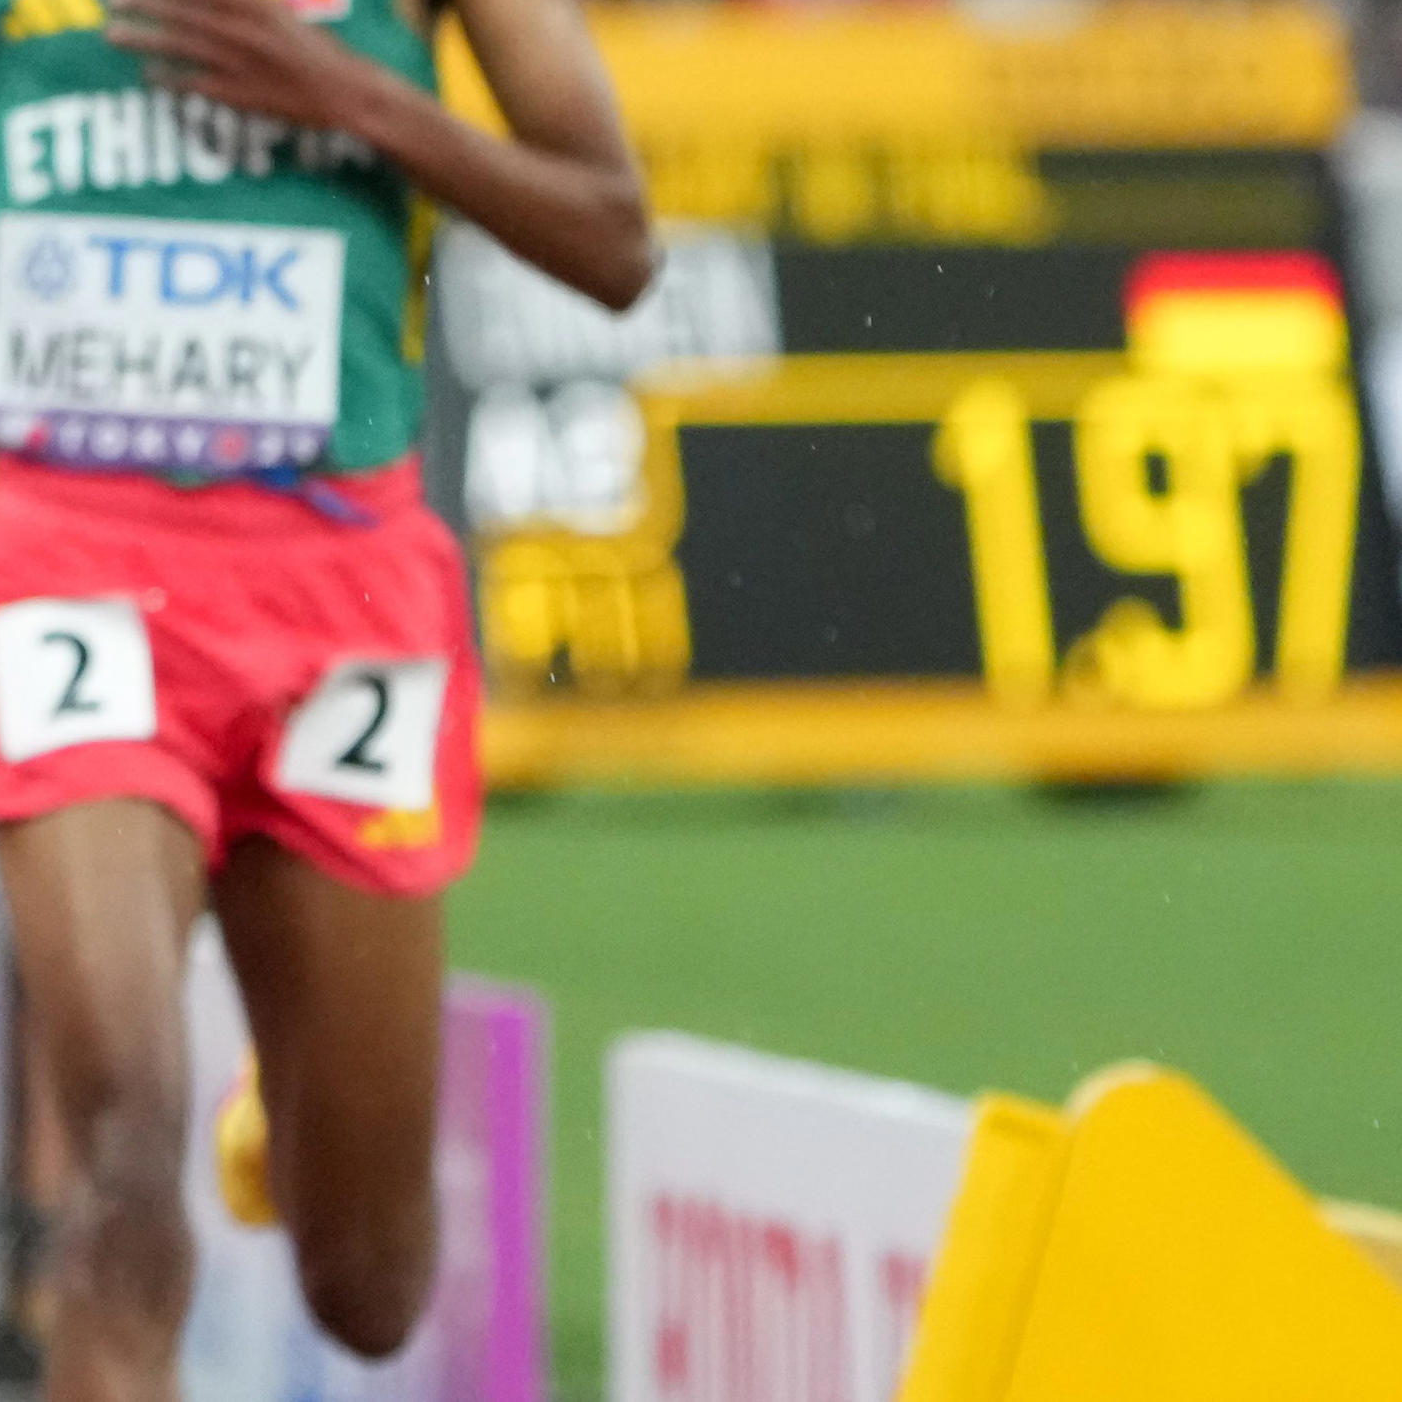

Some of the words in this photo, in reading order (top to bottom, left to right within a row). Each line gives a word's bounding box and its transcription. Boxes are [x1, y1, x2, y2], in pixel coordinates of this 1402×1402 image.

[90, 234, 300, 312] TDK
[8, 328, 314, 400] MEHARY
[40, 629, 100, 719] 2
[335, 671, 386, 773] 2
